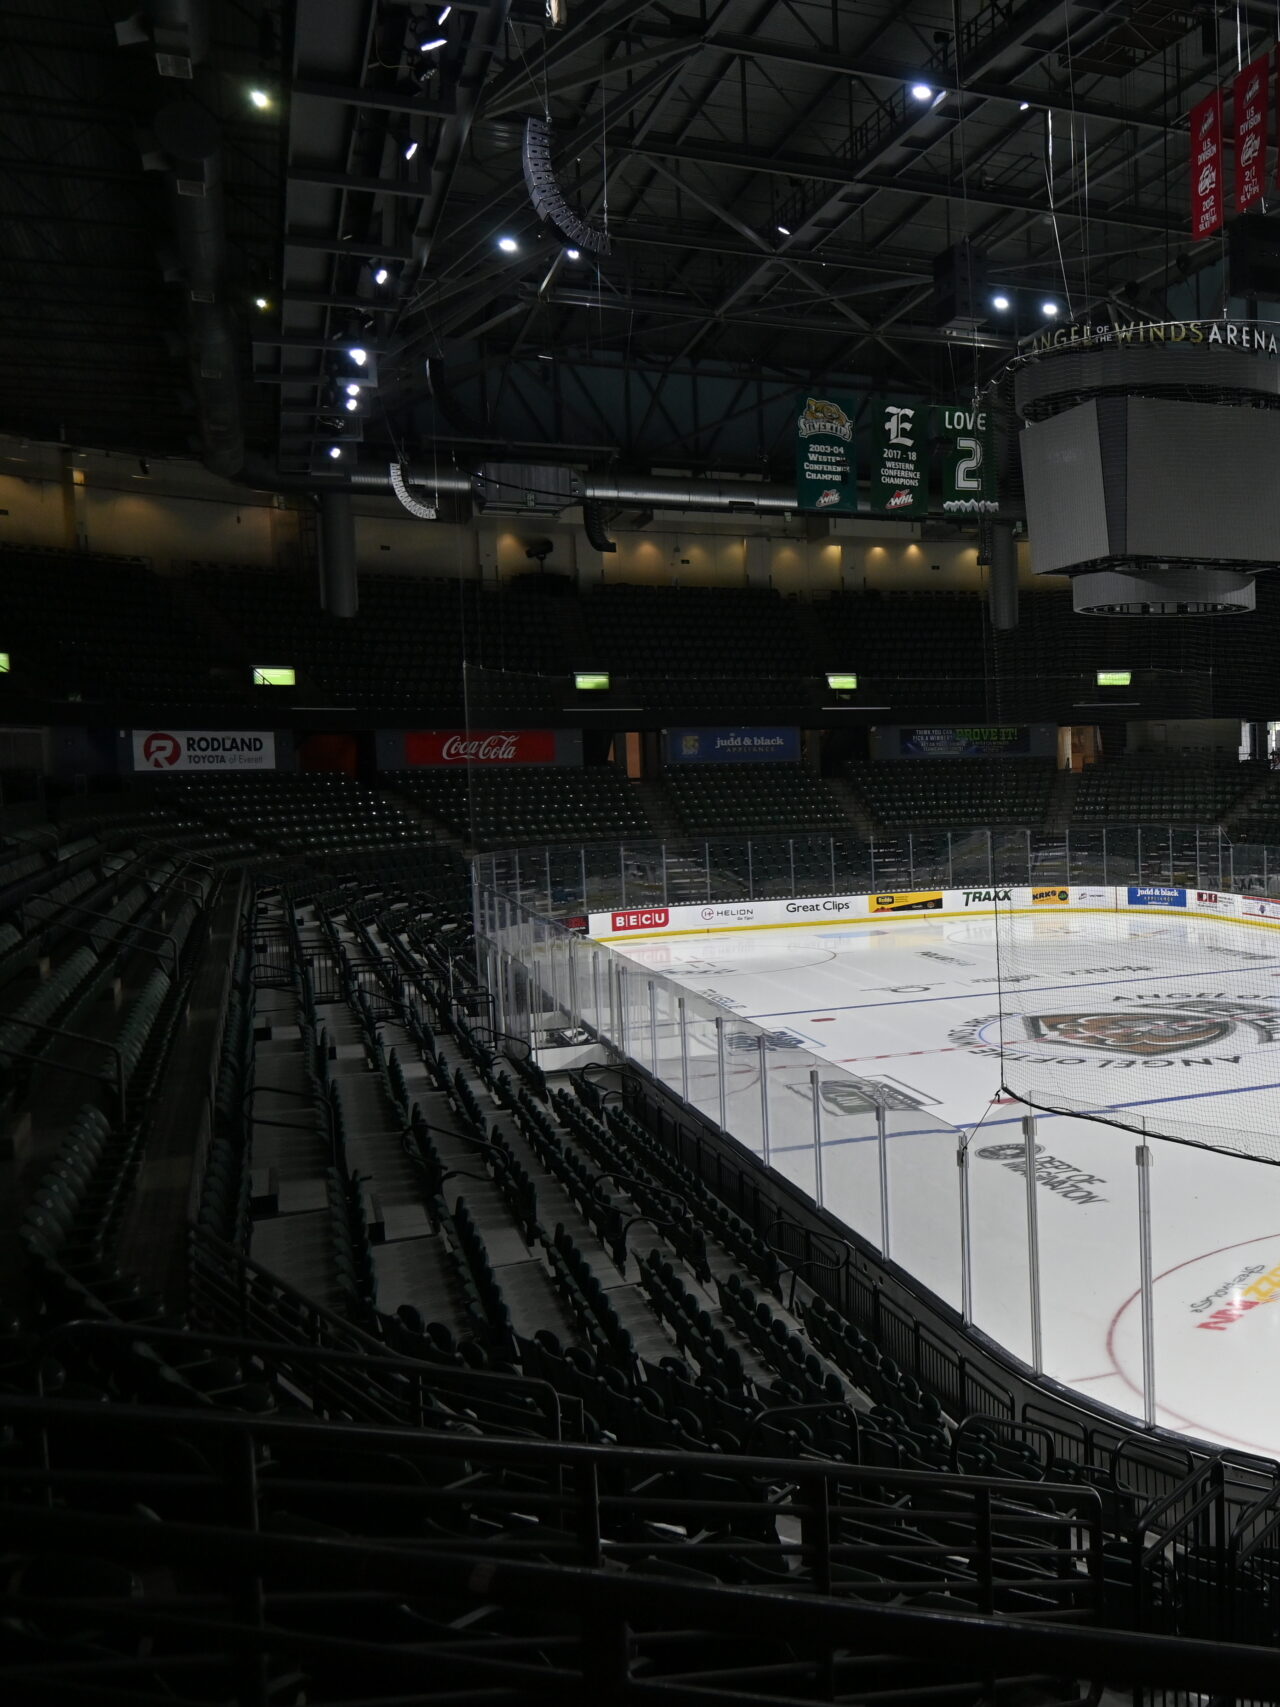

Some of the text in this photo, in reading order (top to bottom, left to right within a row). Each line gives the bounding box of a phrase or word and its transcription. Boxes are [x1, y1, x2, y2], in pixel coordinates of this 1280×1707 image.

[1032, 322, 1278, 354] ANGEL OF THE WINDS ARENA
[885, 405, 915, 447] E
[945, 411, 987, 431] LOVE
[809, 444, 844, 454] 2003-04
[883, 449, 902, 459] 2017
[907, 451, 917, 461] 18
[885, 461, 914, 470] WESTERN
[954, 437, 982, 490] 2
[881, 469, 921, 479] CONFERENCE
[881, 477, 920, 487] CHAMPIONS
[955, 727, 1018, 741] PROVE IT!
[187, 737, 263, 752] RODLAND
[442, 735, 520, 760] Coca-Cola
[715, 736, 785, 749] judd & black
[188, 754, 263, 764] TOYOTA of Everett
[962, 889, 1013, 907] TRAXX
[1136, 888, 1179, 897] judd & black
[717, 908, 754, 917] HELION
[786, 901, 850, 913] Great Clips
[1096, 1054, 1239, 1068] ANGEL
[1036, 1156, 1107, 1185] DEPT OF
